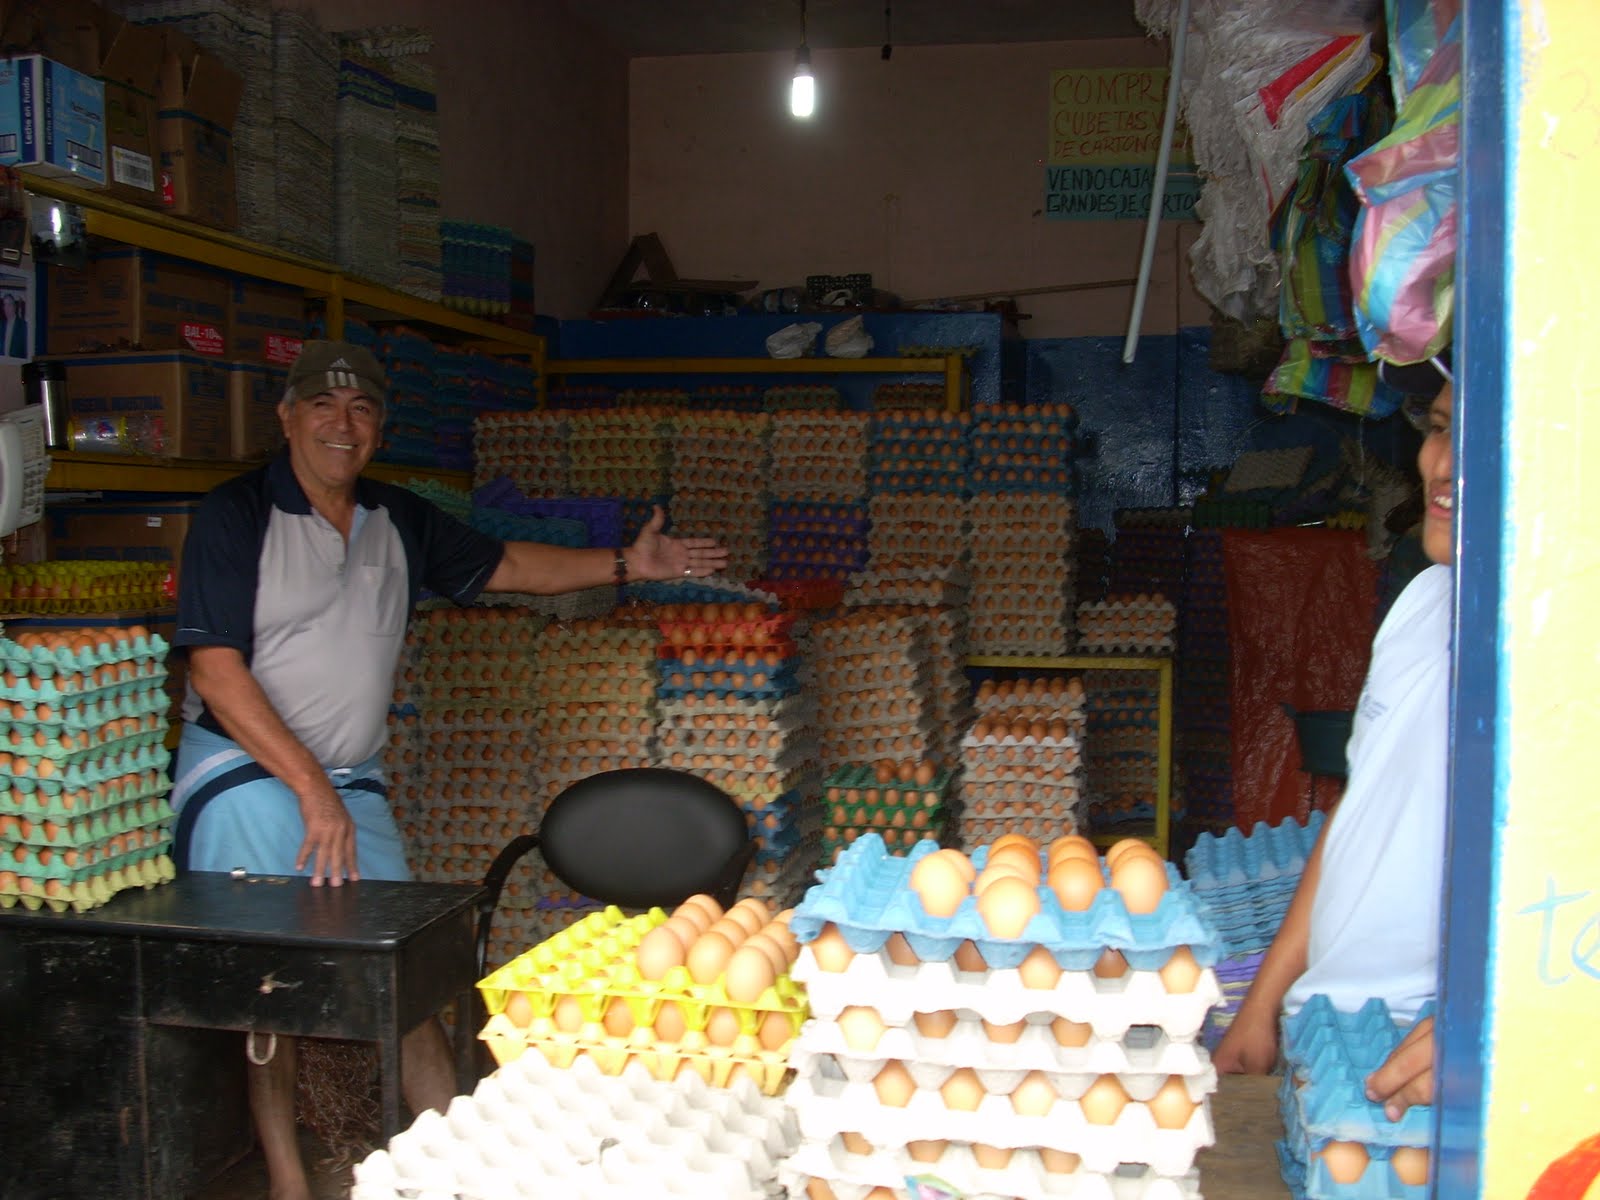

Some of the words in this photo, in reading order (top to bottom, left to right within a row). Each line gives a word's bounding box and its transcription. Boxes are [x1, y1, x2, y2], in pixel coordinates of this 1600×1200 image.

[22, 76, 32, 104] Funda
[23, 118, 33, 145] Leche
[1054, 109, 1147, 136] CUBETAS
[1054, 139, 1075, 158] DE
[1079, 134, 1149, 156] CARTON
[1047, 168, 1105, 191] VENDO
[1110, 168, 1156, 188] CAJA
[1046, 193, 1117, 213] GRANDES
[1119, 194, 1138, 214] DE
[1142, 192, 1201, 213] CRTO
